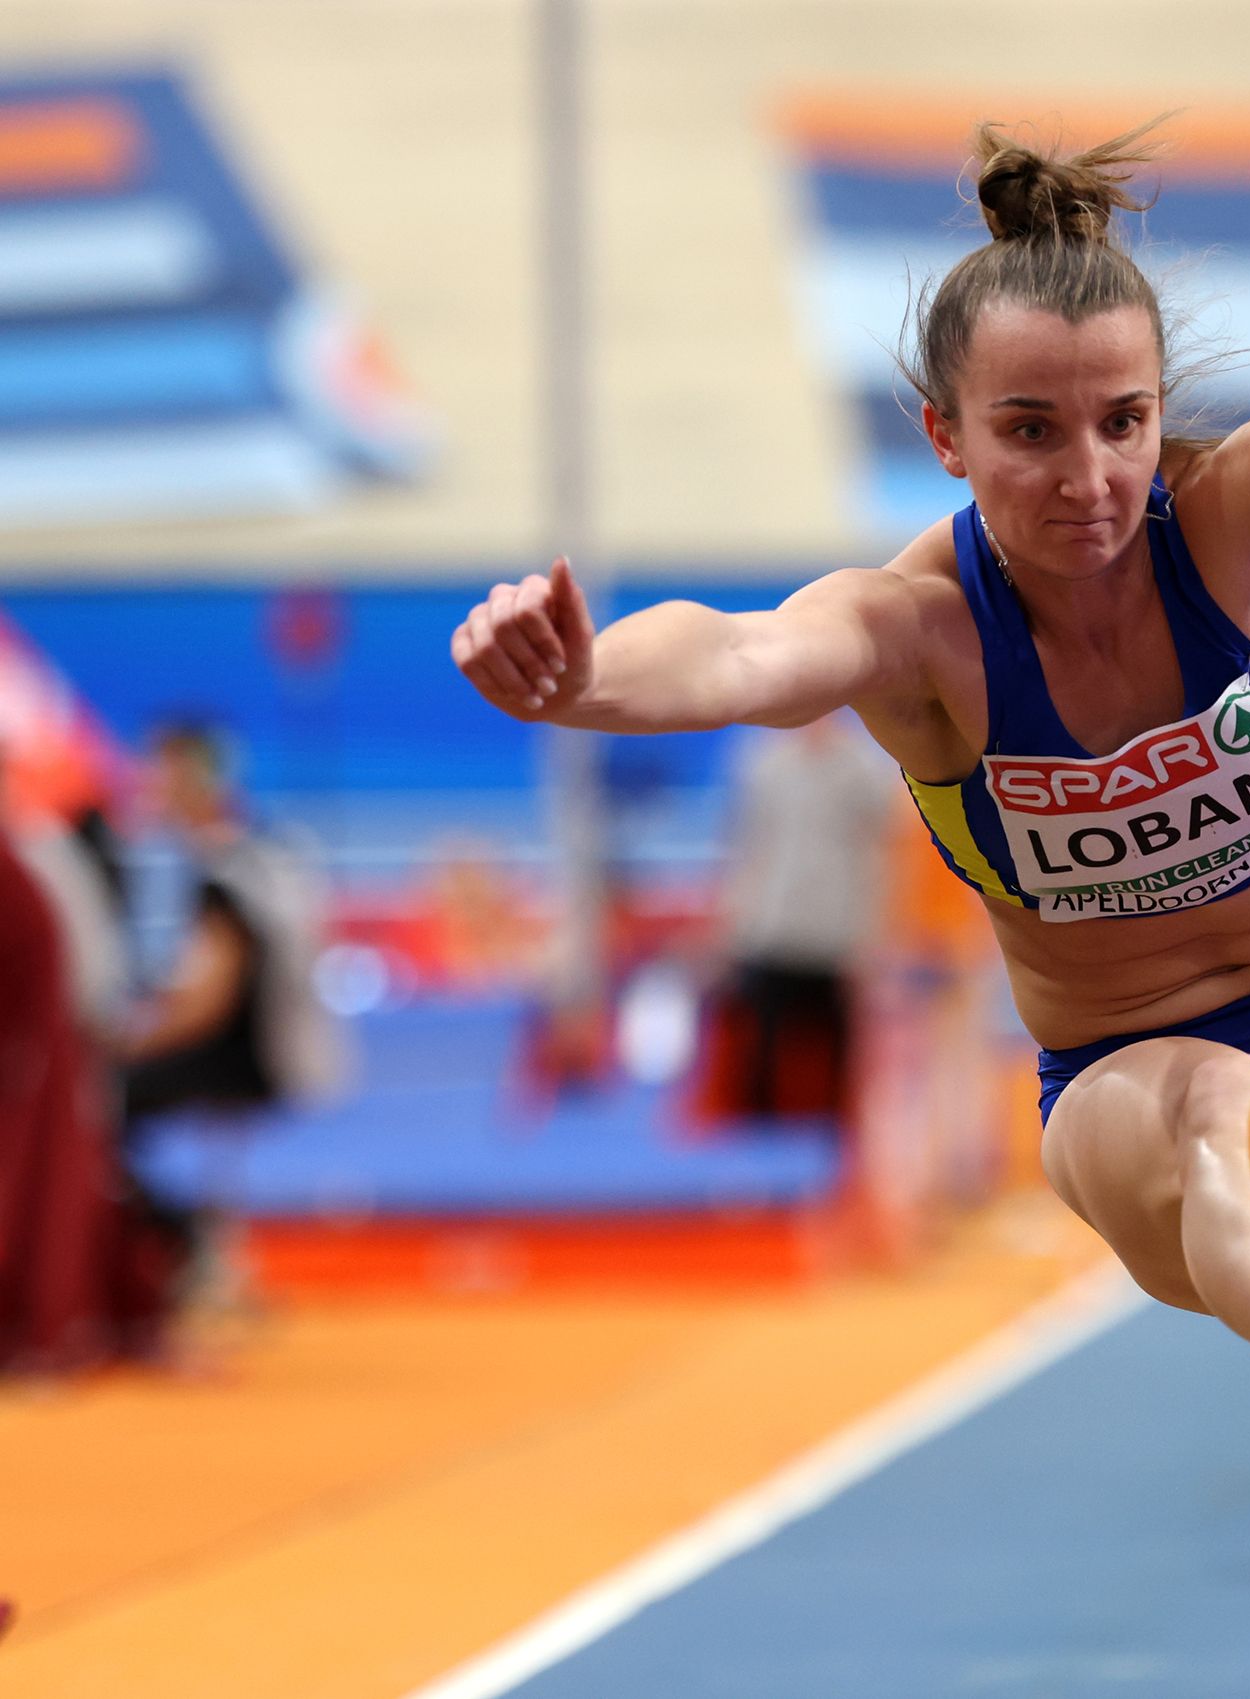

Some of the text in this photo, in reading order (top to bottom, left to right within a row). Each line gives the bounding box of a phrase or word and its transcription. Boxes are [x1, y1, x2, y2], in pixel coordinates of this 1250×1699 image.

[1000, 734, 1209, 808] SPAR
[1052, 860, 1250, 913] APELDOORN
[1106, 872, 1169, 894] RUN
